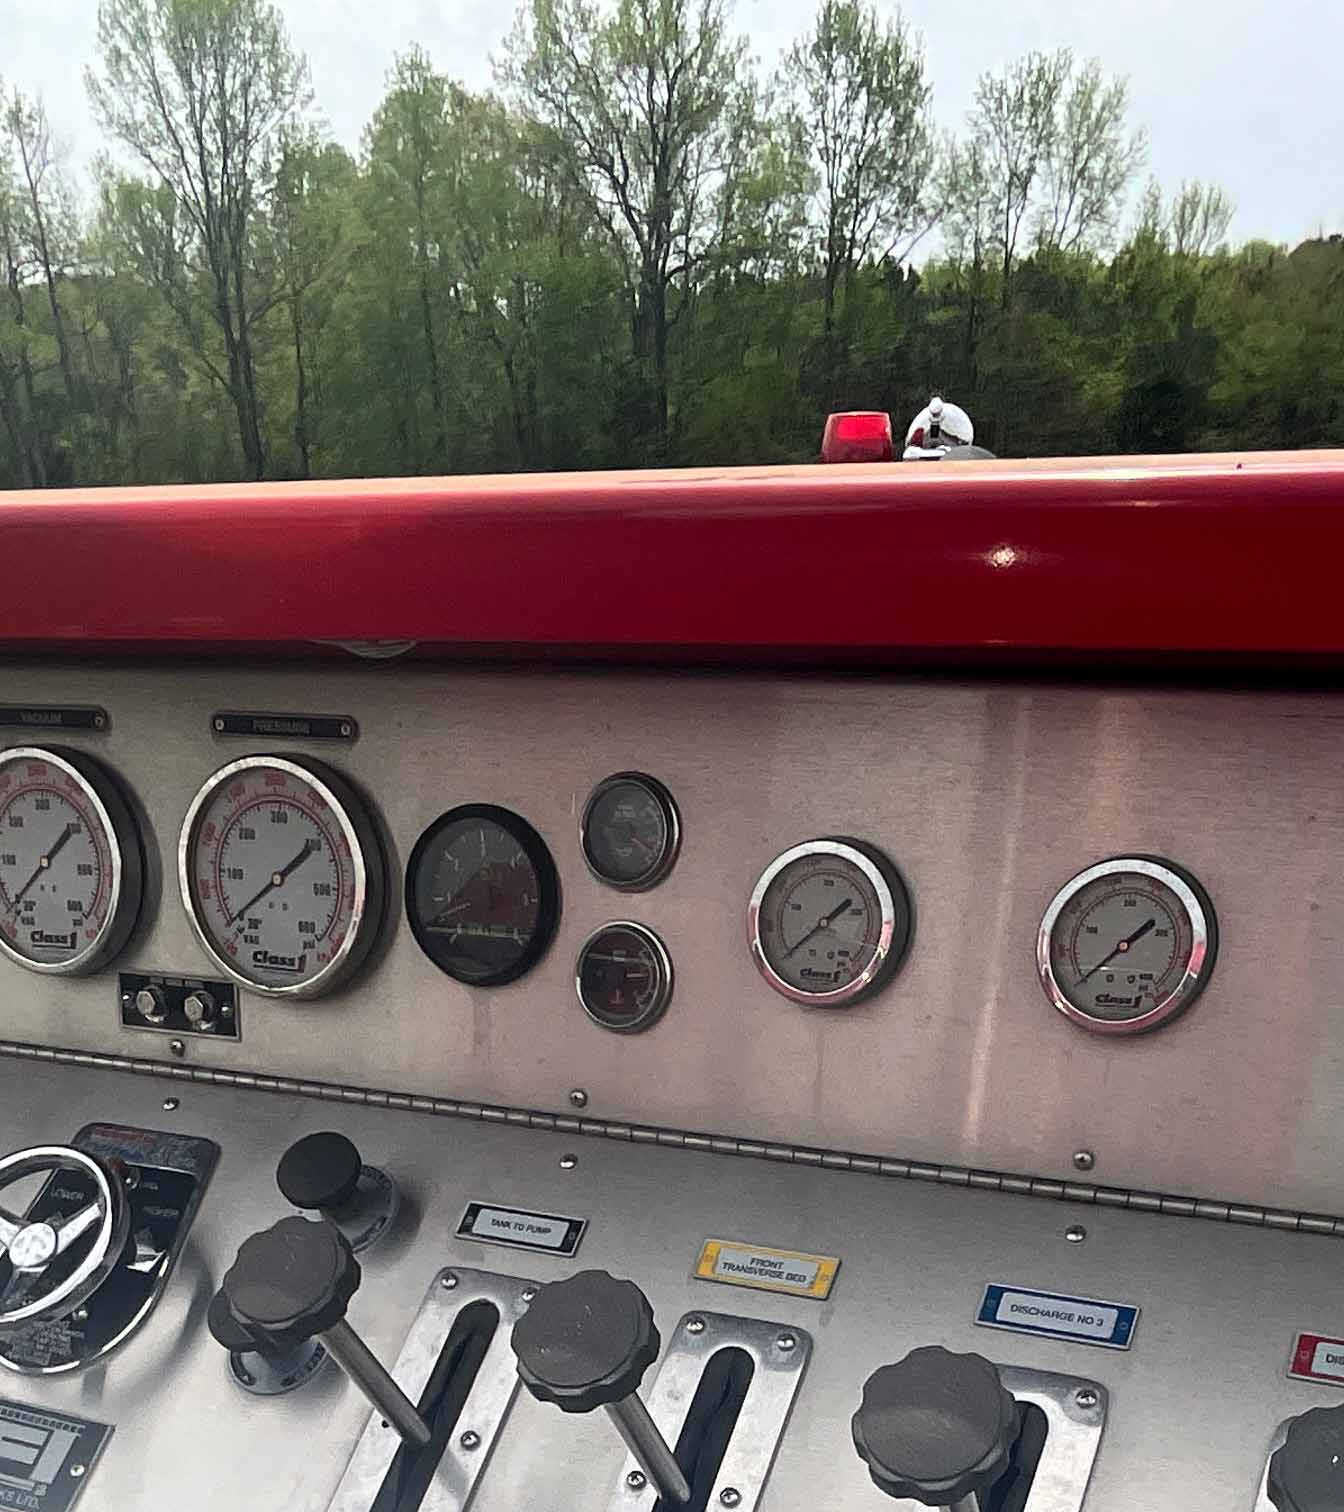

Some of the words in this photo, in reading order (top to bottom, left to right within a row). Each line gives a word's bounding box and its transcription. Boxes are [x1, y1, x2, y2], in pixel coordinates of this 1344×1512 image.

[491, 1218, 511, 1230] TANK
[512, 1222, 525, 1232] TO
[526, 1224, 552, 1234] PUMP
[722, 1262, 785, 1280] TRANSVERSE
[749, 1257, 784, 1270] FRONT
[1010, 1304, 1076, 1323] DISCHARGE
